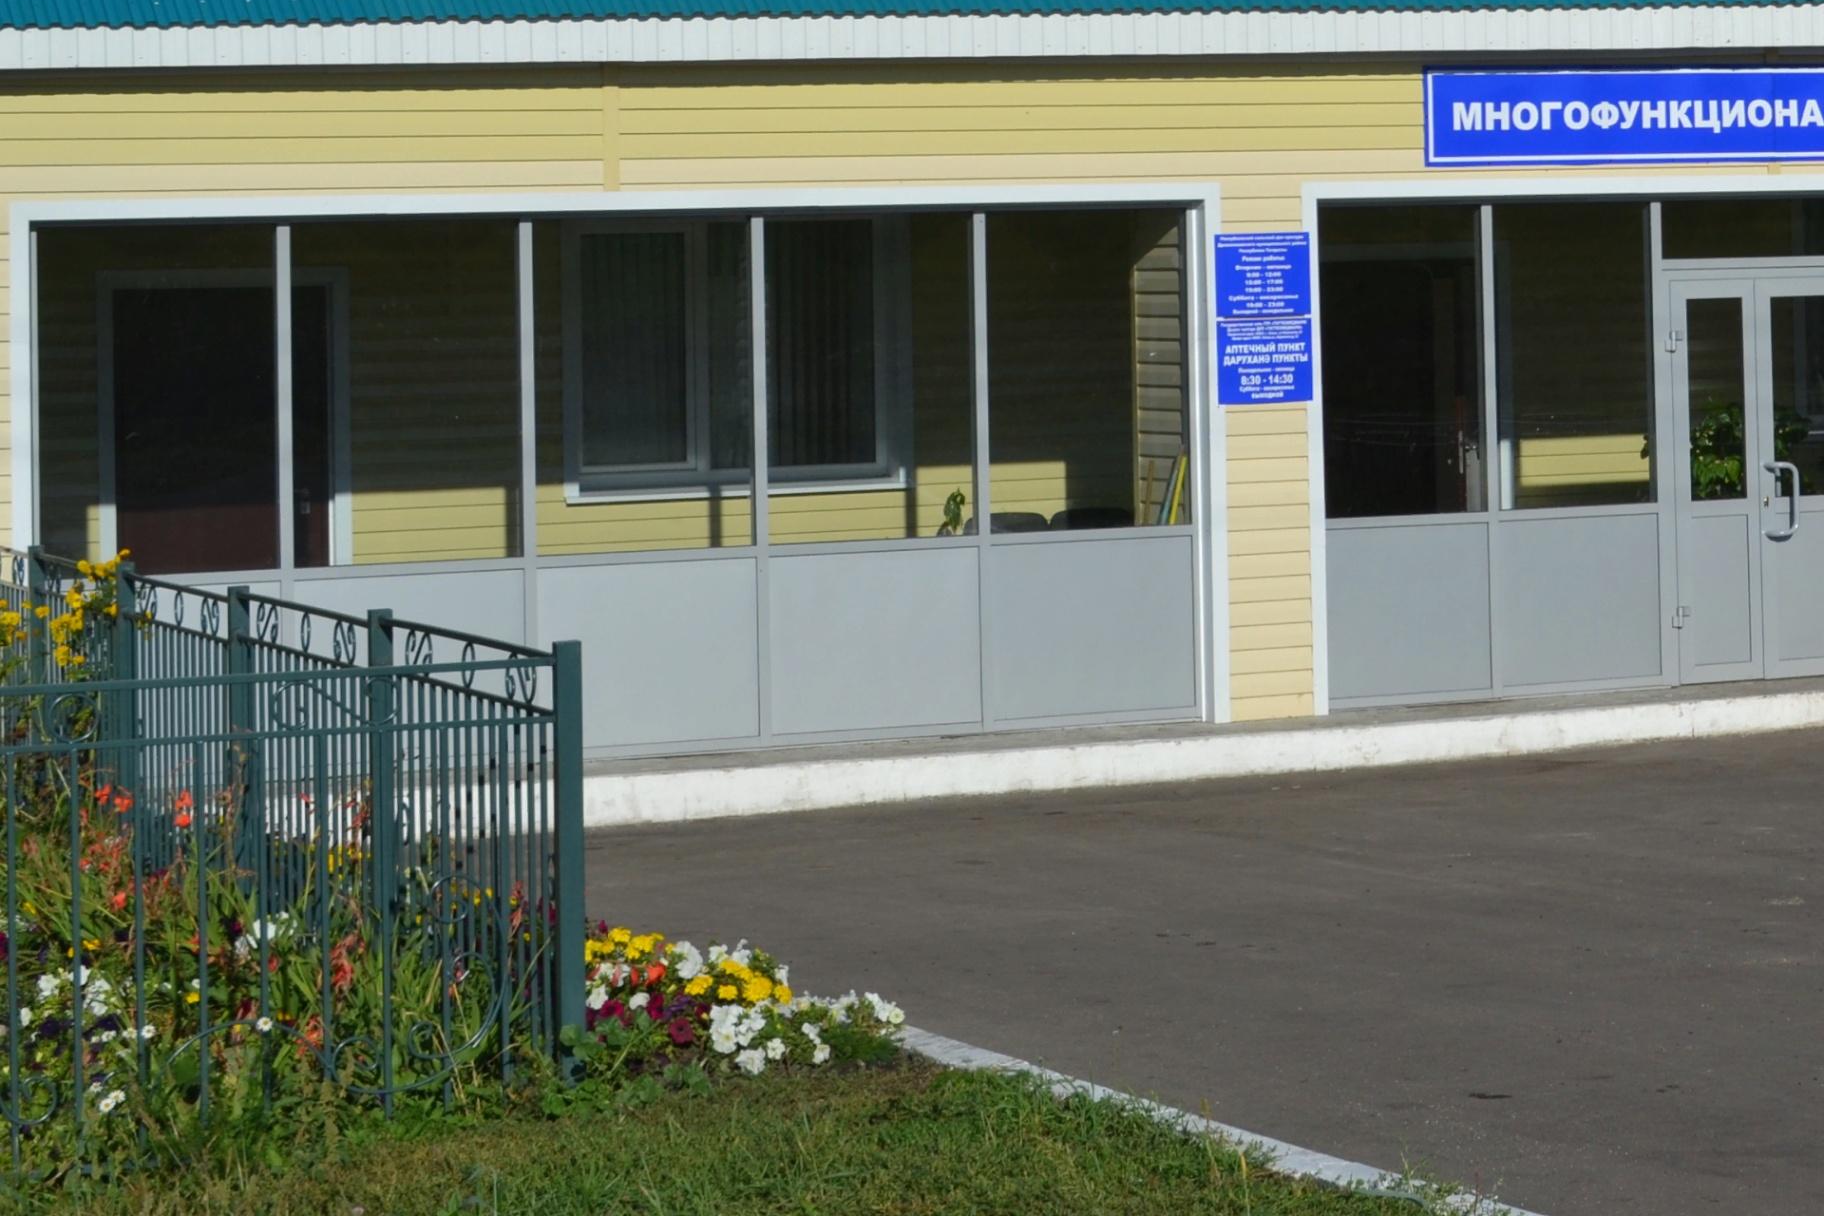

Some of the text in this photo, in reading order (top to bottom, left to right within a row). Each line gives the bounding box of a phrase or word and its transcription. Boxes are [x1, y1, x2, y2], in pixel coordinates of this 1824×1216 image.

[1225, 341, 1305, 354] АПТЕЧНЫЙ ПУНКТ
[1272, 352, 1309, 363] ПУНКТЫ
[1240, 375, 1261, 386] 8:30
[1268, 373, 1294, 384] 14:30
